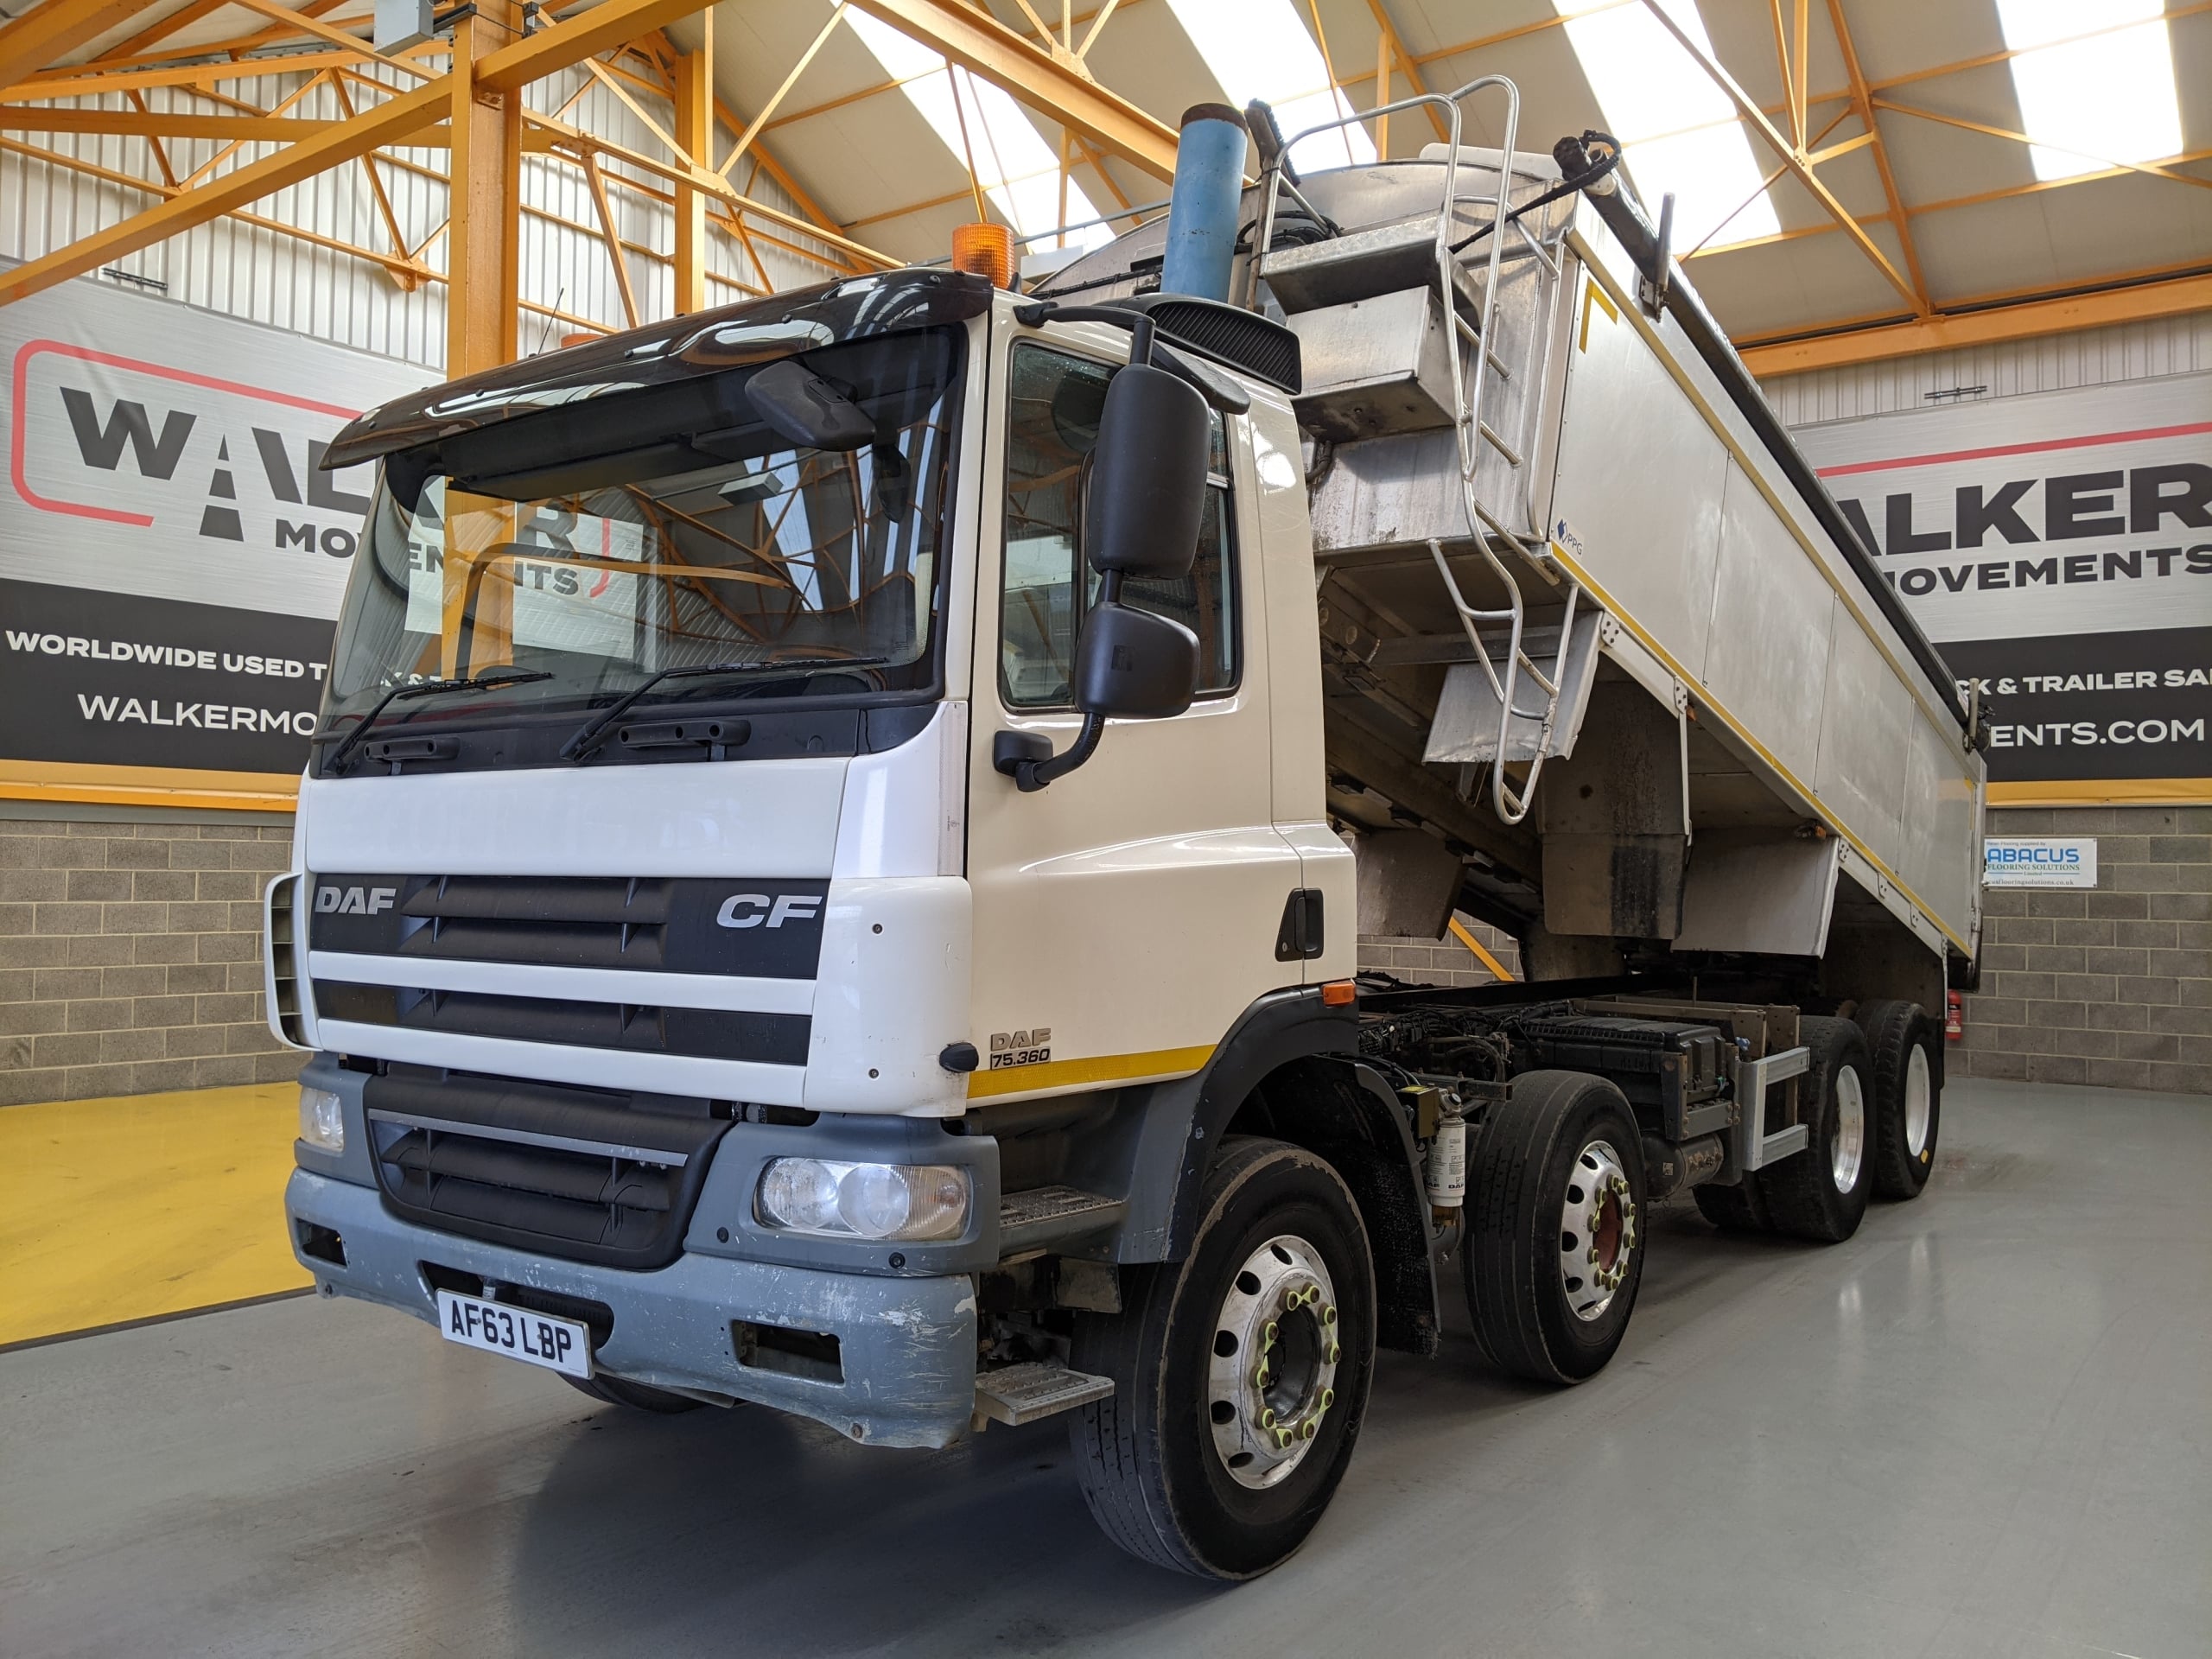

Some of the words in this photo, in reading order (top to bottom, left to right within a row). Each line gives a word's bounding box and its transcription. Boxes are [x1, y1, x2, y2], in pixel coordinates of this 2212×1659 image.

[1567, 532, 1583, 556] PPG
[6, 630, 217, 671] WORLDWIDE
[223, 653, 304, 678] USED
[1997, 677, 2018, 695] &
[2023, 671, 2158, 693] TRAILER
[2164, 669, 2212, 687] SA
[1987, 849, 2080, 862] ABACUS
[315, 887, 397, 914] DAF
[716, 894, 822, 928] CF
[990, 1028, 1051, 1051] DAF
[992, 1048, 1050, 1068] 75.360
[452, 1300, 515, 1349] AF63
[520, 1318, 571, 1363] LBP
